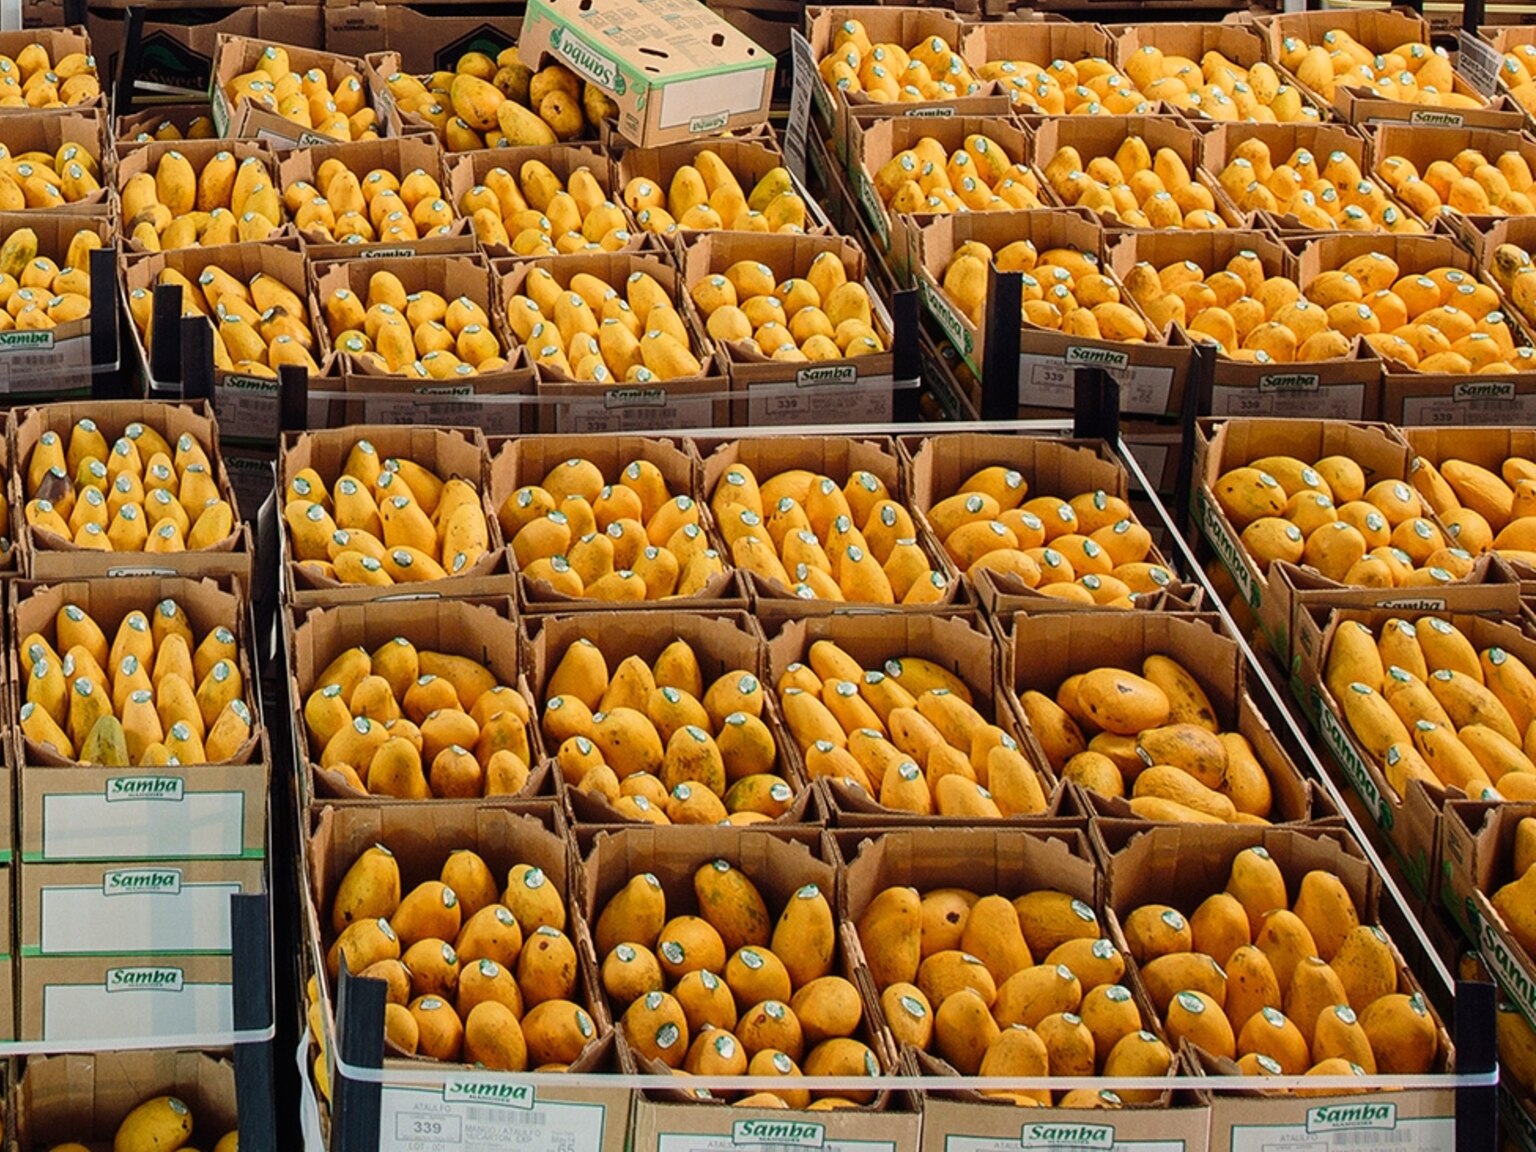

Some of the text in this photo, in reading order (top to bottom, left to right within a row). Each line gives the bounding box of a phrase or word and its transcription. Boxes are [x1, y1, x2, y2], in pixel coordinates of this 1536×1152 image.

[564, 38, 614, 85] Samba
[1414, 112, 1460, 124] Samba
[1070, 348, 1124, 364] Samba
[801, 366, 851, 381] Samba
[1264, 376, 1315, 388] Samba
[1321, 711, 1379, 806] Samba
[113, 779, 178, 795] Samba
[110, 873, 175, 889] Samba
[450, 1081, 528, 1100] Samba
[1313, 1106, 1390, 1125] Samba
[414, 1121, 442, 1135] 339
[740, 1121, 818, 1141] Samba
[1028, 1125, 1107, 1143] Samba
